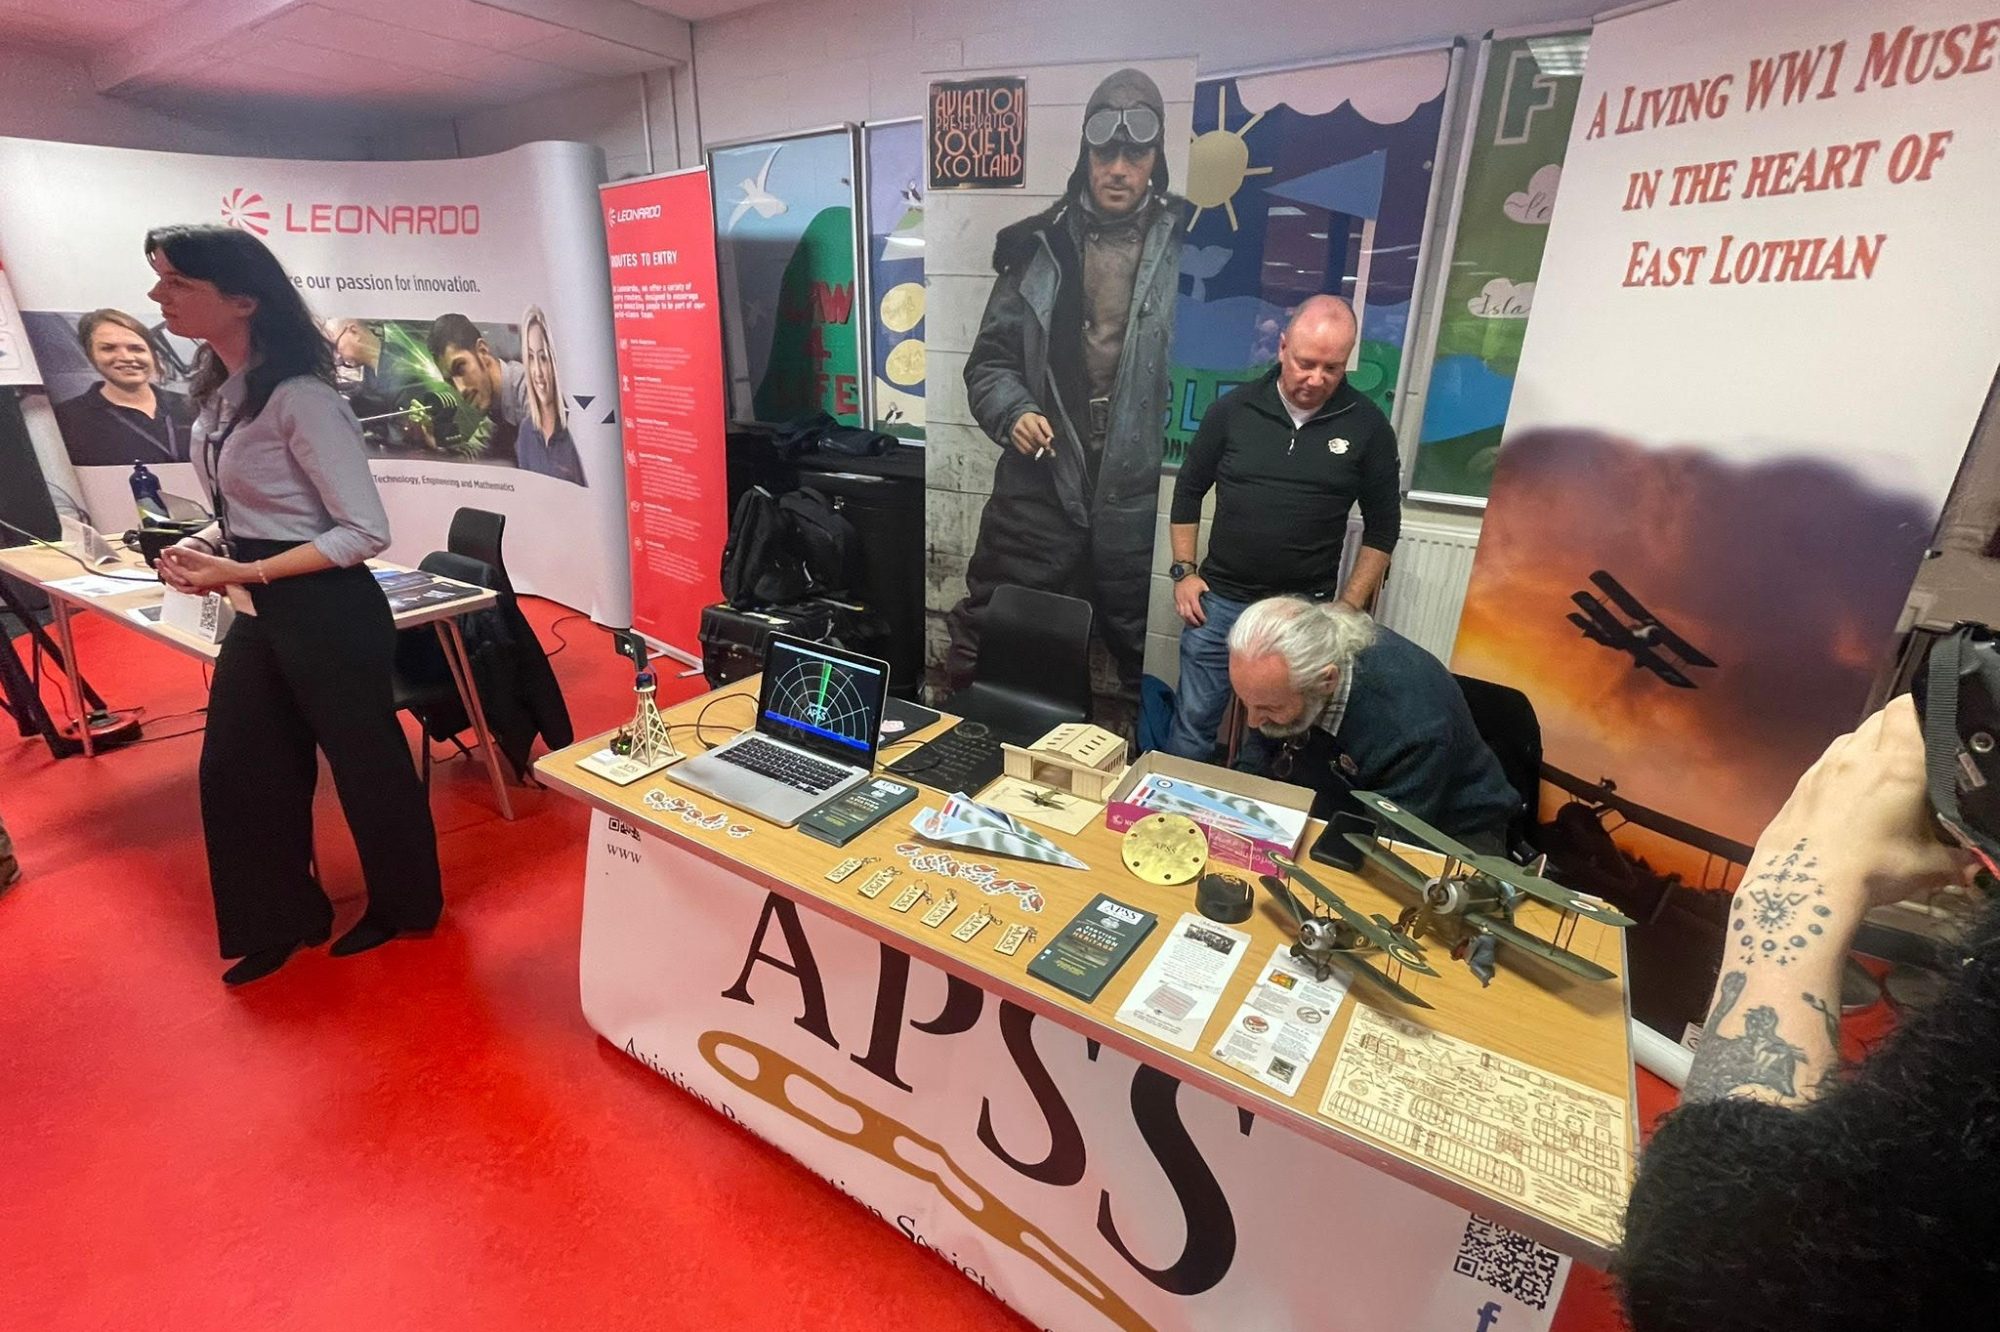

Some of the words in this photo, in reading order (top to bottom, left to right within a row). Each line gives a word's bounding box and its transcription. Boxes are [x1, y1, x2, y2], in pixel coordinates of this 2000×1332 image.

[936, 87, 1023, 116] AVIATION
[1586, 91, 1606, 141] A
[1614, 74, 1734, 135] LIVING
[1745, 39, 1848, 112] WW1
[935, 127, 1023, 158] SOCIETY
[935, 153, 1022, 178] SCOTLAND
[1622, 168, 1663, 211] IN
[1669, 159, 1738, 207] THE
[1741, 140, 1881, 199] HEART
[1887, 130, 1954, 184] OF
[286, 203, 480, 235] LEONARDO
[617, 205, 661, 222] LEONARDO
[640, 252, 651, 266] TO
[653, 250, 678, 266] ENTRY
[1622, 241, 1707, 287] EAST
[1709, 234, 1887, 285] LOTHIAN
[306, 275, 330, 289] our
[336, 274, 393, 292] passion
[395, 274, 411, 291] for
[413, 275, 481, 293] innovation.
[461, 480, 473, 489] and
[474, 480, 515, 492] Mathematics
[1104, 904, 1137, 920] APSS
[1072, 931, 1114, 952] HERITAGE
[1076, 927, 1119, 947] AVIATION
[720, 889, 1255, 1296] APSS
